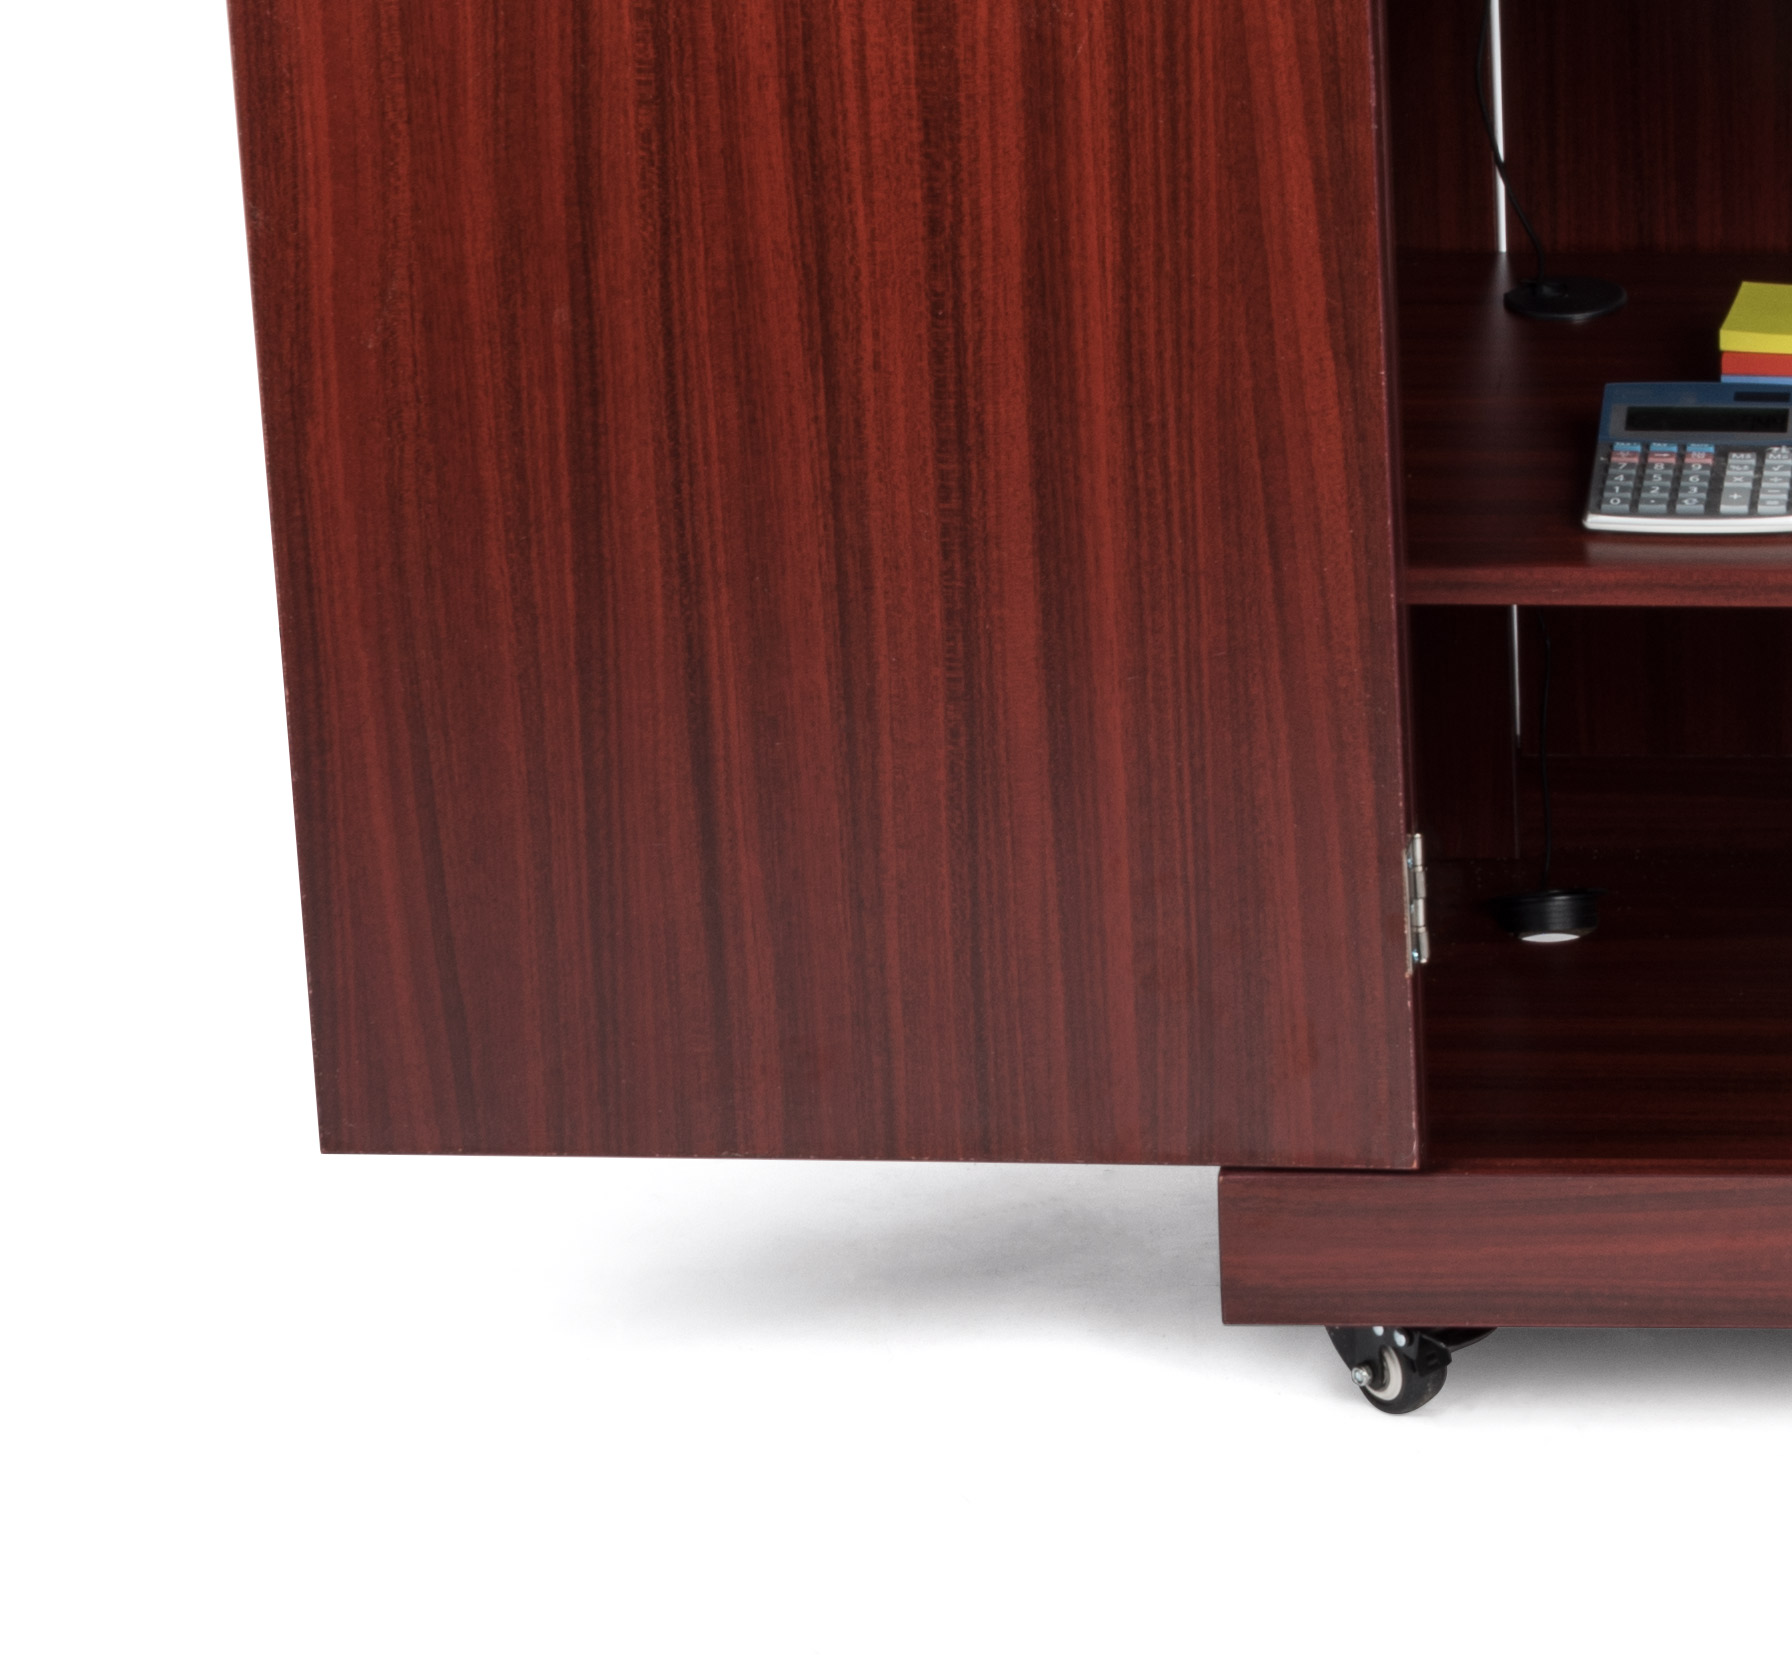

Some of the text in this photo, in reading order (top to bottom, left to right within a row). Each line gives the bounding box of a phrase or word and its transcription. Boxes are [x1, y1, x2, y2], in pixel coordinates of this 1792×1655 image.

[1653, 462, 1665, 471] 8
[1690, 462, 1702, 471] 9
[1613, 473, 1700, 483] 4 5 6
[1613, 485, 1698, 494] 1 2 3
[1609, 497, 1621, 506] 0
